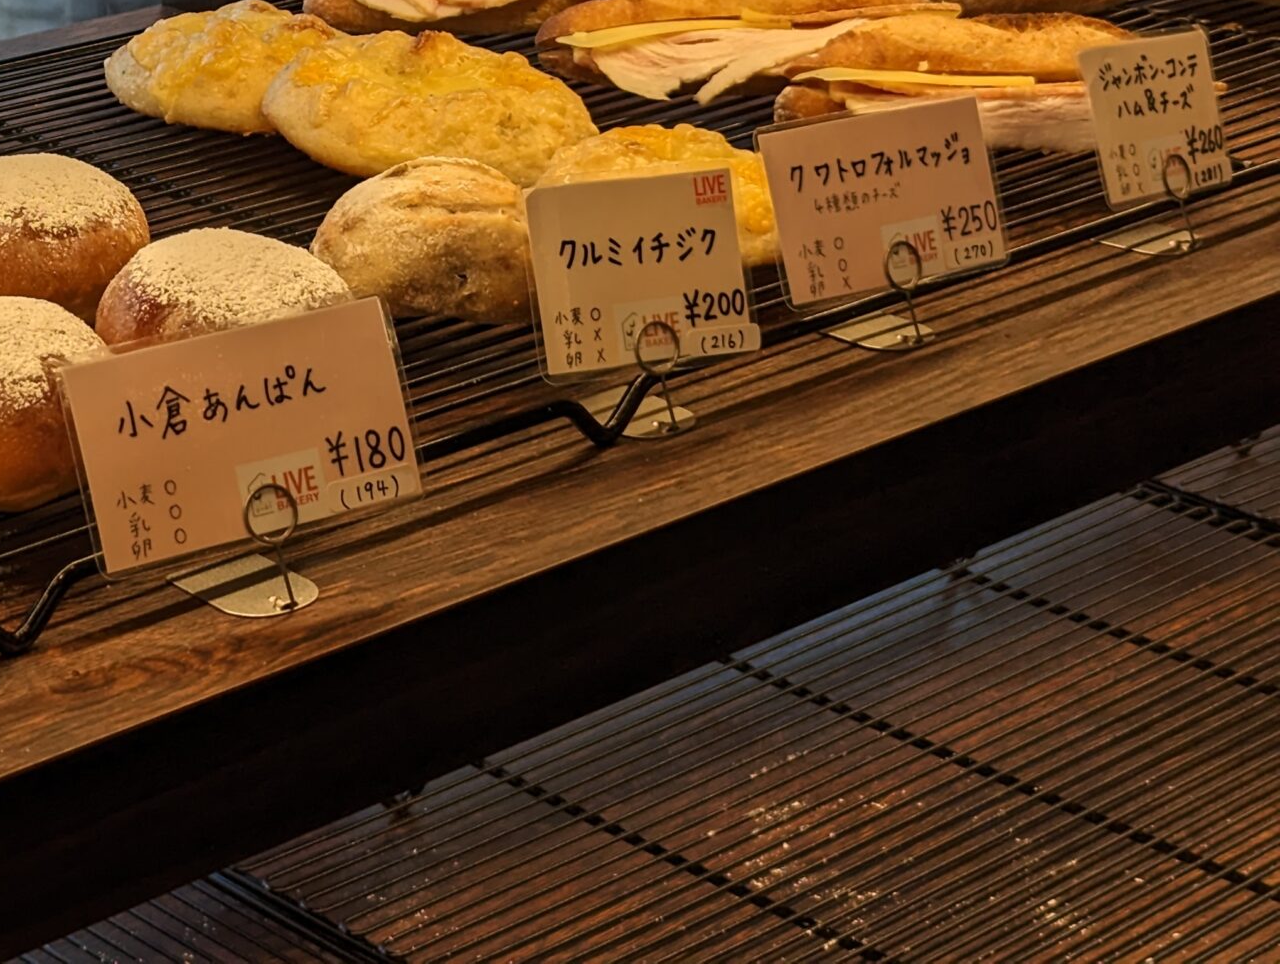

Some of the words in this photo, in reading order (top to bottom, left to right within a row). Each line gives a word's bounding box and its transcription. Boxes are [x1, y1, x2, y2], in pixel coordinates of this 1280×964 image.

[1184, 125, 1223, 165] ¥260
[693, 174, 727, 196] LIVE
[940, 200, 998, 241] ¥250
[559, 226, 716, 270] クルミイチジク
[954, 240, 995, 265] (270)
[642, 311, 681, 337] LIVE
[682, 288, 745, 328] ¥200
[700, 329, 745, 355] (216)
[117, 365, 326, 440] 小倉あんぱん
[324, 425, 407, 477] ¥180
[271, 464, 319, 499] LIVE
[339, 475, 400, 510] (194)
